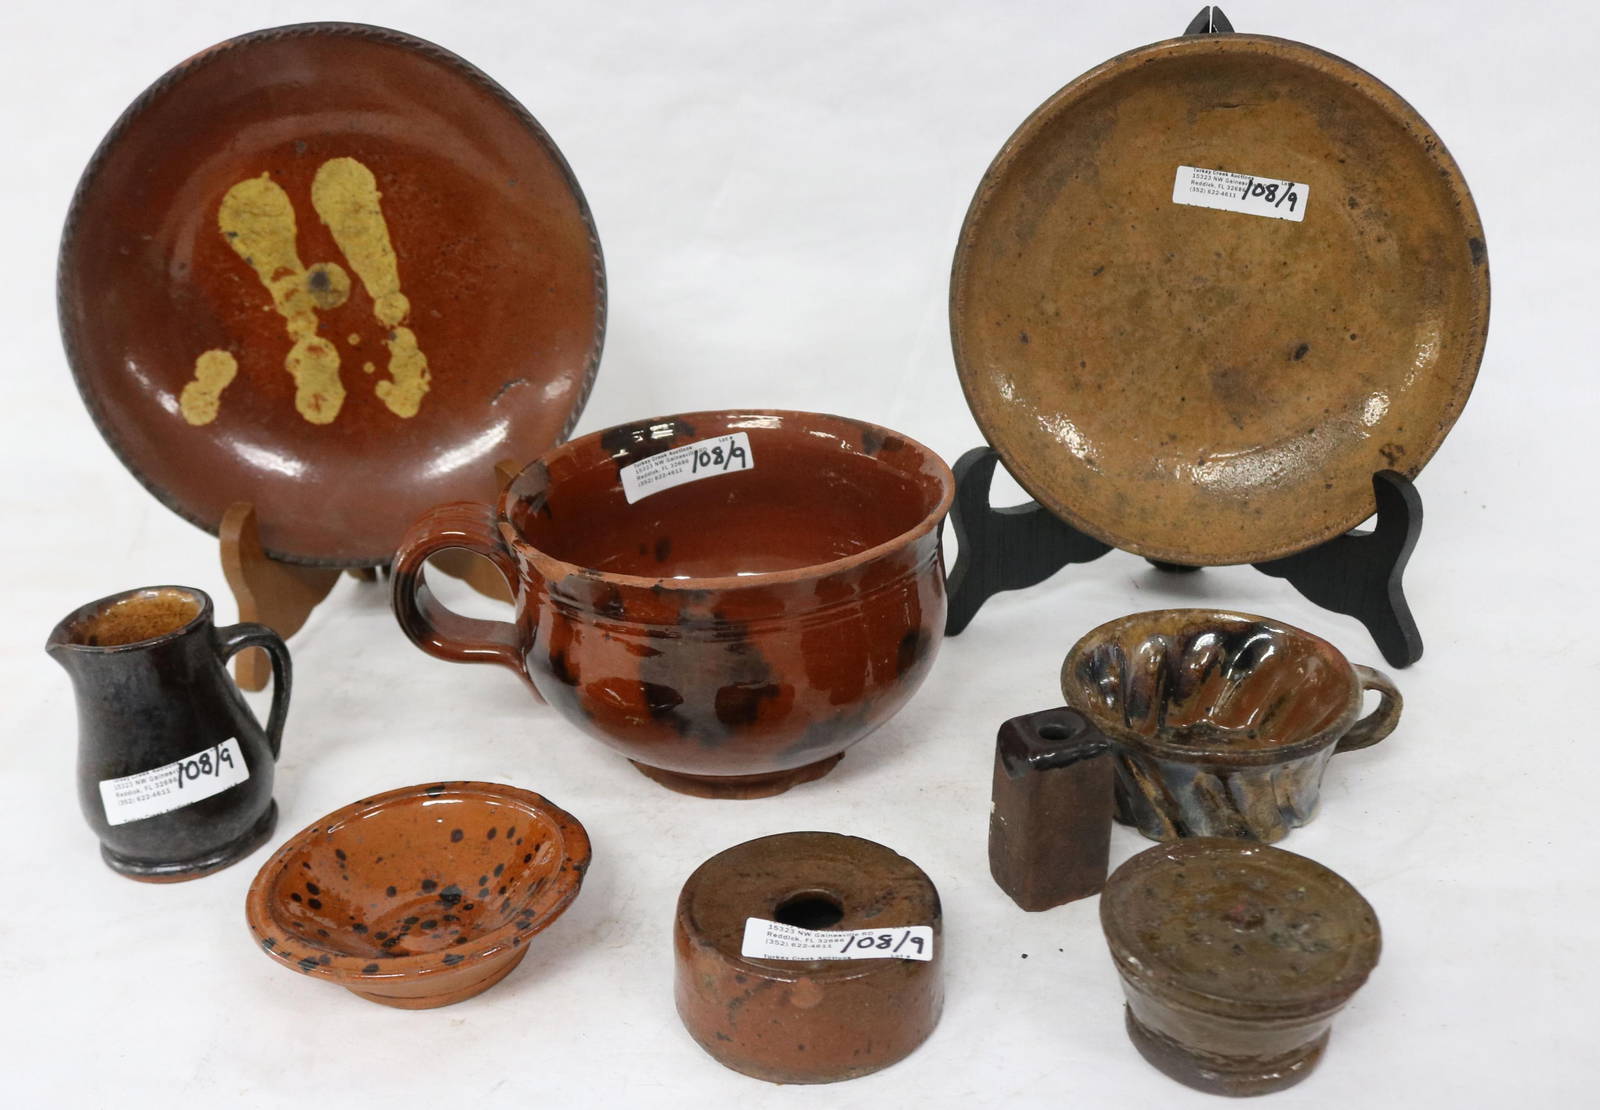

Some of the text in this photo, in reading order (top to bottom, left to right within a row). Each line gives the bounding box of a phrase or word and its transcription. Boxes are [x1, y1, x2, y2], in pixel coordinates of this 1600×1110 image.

[1241, 179, 1298, 212] 108/9
[692, 439, 746, 474] 108/9
[178, 745, 234, 789] 108/9
[840, 930, 925, 954] 108/9
